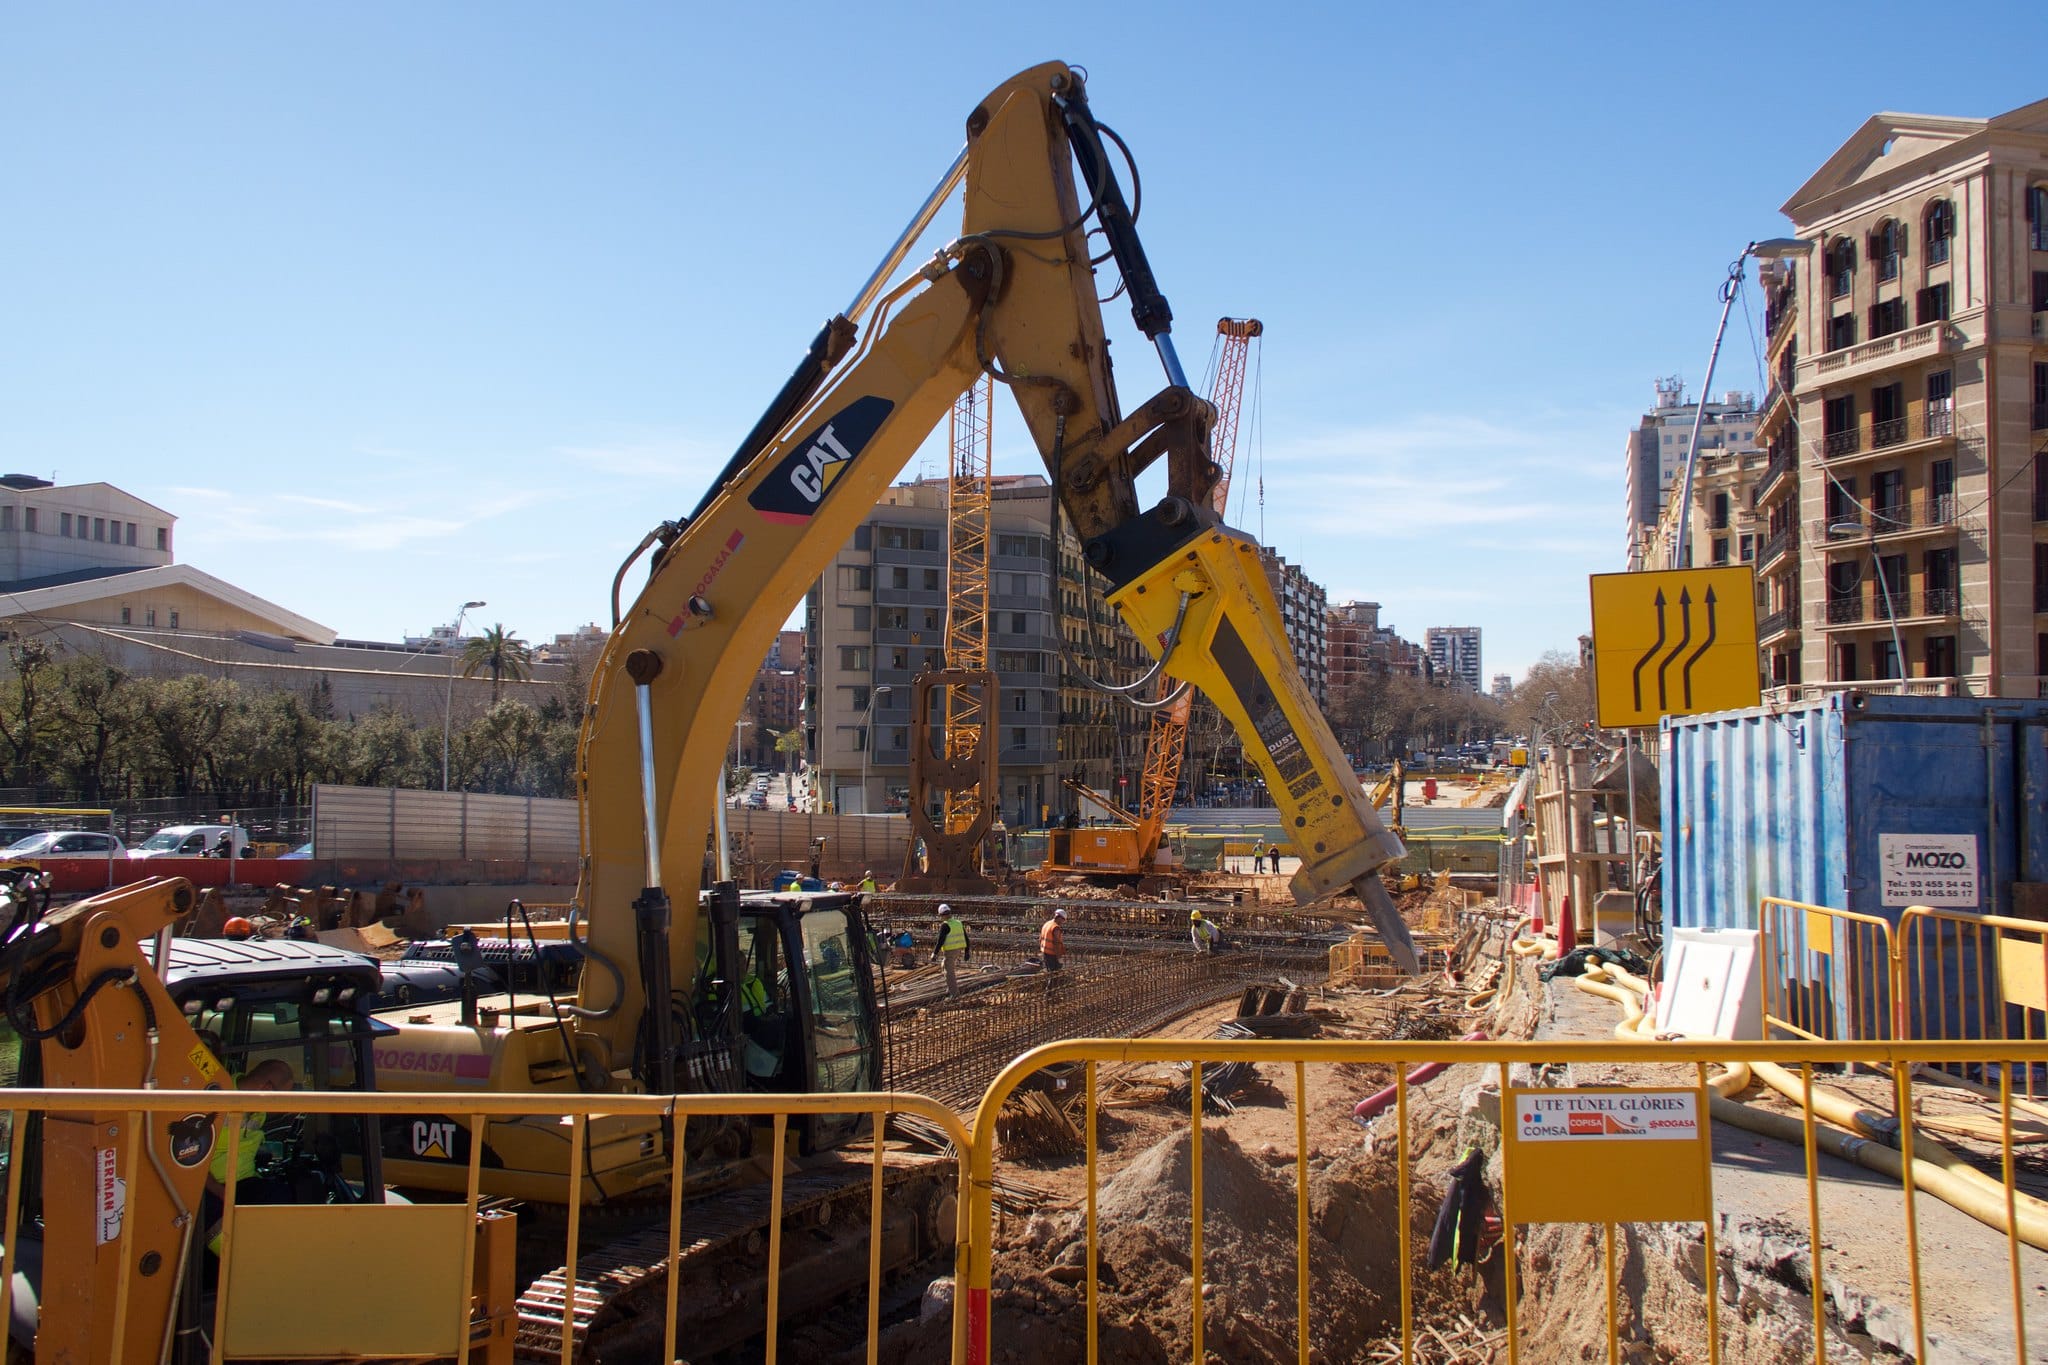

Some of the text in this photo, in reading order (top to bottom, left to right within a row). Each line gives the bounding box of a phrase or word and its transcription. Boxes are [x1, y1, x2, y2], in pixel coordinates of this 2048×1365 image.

[790, 424, 852, 503] CAT
[1268, 732, 1294, 752] DUST
[1906, 852, 1966, 869] MOZO
[1910, 880, 1922, 888] 93
[1925, 880, 1943, 888] 455
[1946, 880, 1958, 888] 54
[1887, 889, 1908, 897] Fax:
[1910, 889, 1923, 897] 93
[1535, 1096, 1685, 1111] UTE TÚNEL GLÒRIES
[1524, 1126, 1569, 1136] COMSA
[1570, 1119, 1603, 1127] COPISA
[412, 1121, 457, 1159] CAT
[179, 1144, 200, 1156] CASE
[104, 1148, 115, 1212] GERMAN
